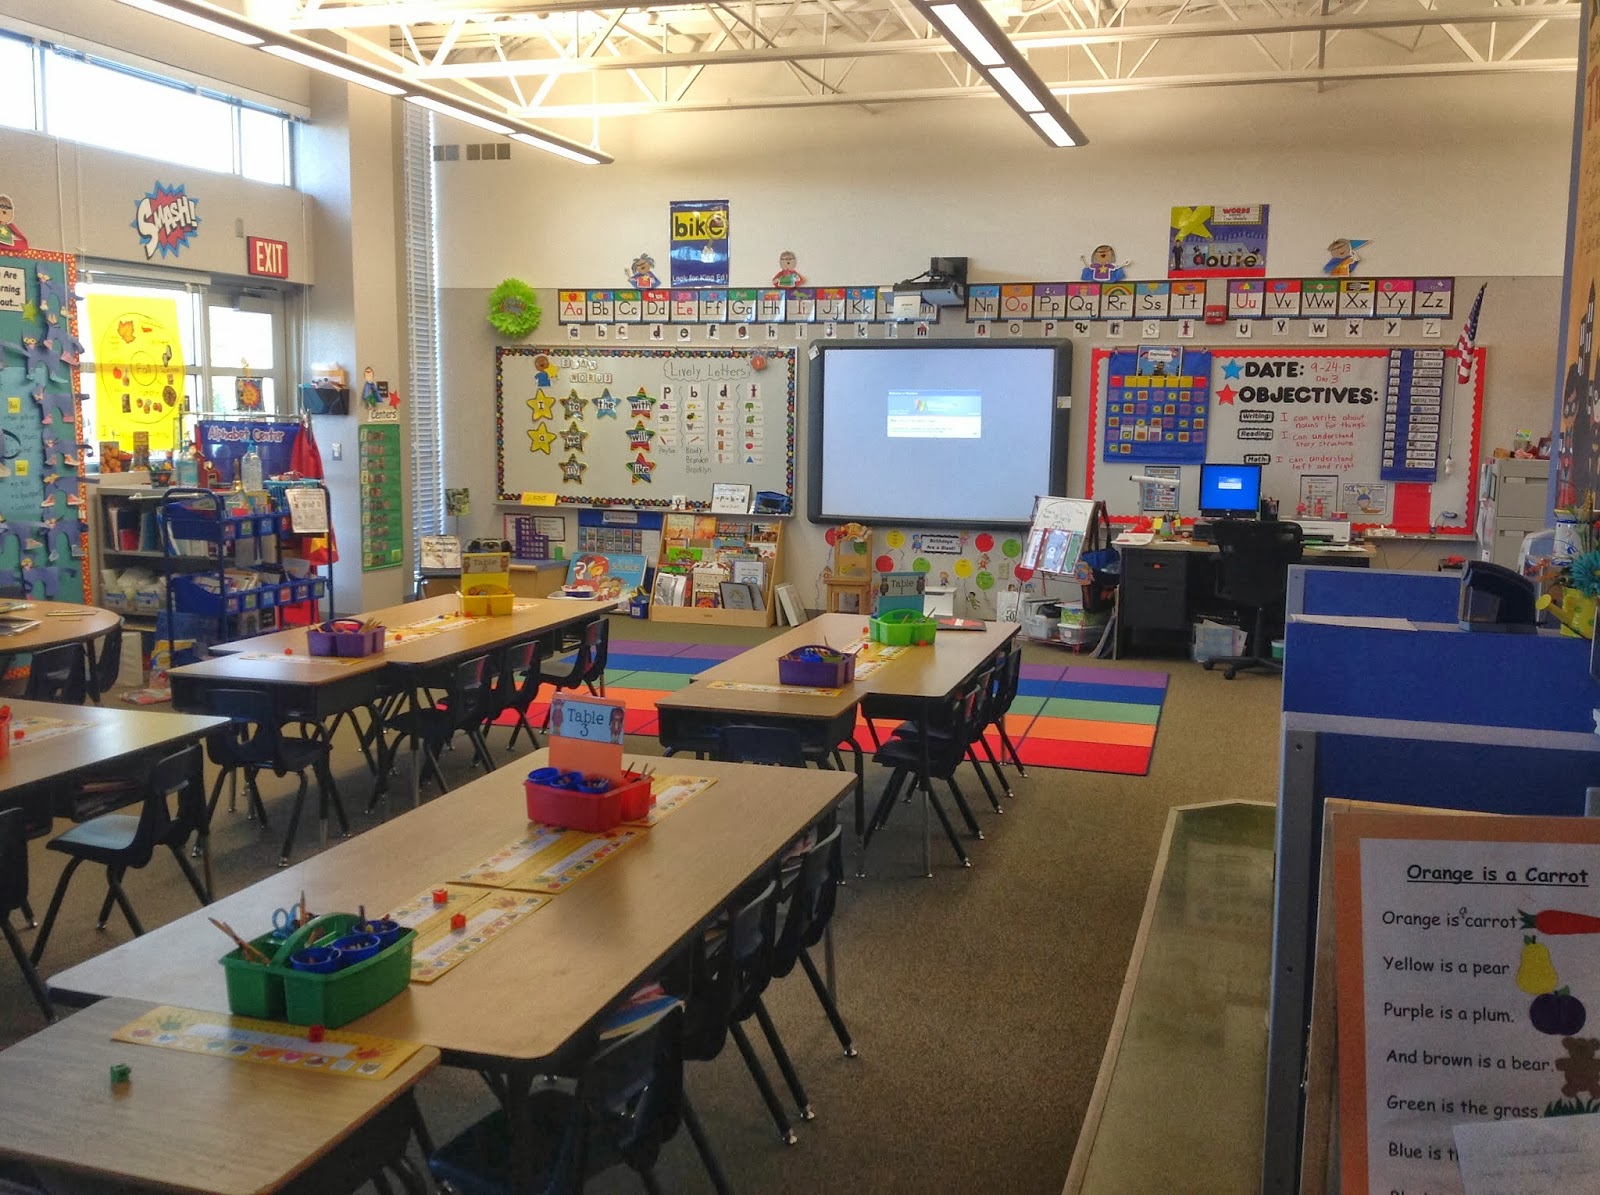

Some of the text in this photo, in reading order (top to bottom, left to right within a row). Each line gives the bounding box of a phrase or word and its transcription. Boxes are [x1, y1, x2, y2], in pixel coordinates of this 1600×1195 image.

[137, 196, 198, 260] SMASH!
[674, 214, 724, 237] bike
[256, 241, 283, 274] EXIT
[4, 270, 17, 279] Are
[0, 285, 20, 296] rning
[0, 299, 19, 307] out...
[563, 301, 583, 316] Aa
[592, 301, 609, 316] Bb
[619, 301, 637, 315] Cc
[647, 301, 665, 315] Dd
[676, 301, 693, 315] Ee
[705, 301, 721, 315] Ff
[762, 301, 780, 315] Hh
[823, 300, 840, 320] Jj
[852, 300, 870, 314] Kk
[974, 297, 993, 312] Nn
[1005, 297, 1028, 312] Oo
[1040, 296, 1060, 317] Pp
[1069, 295, 1096, 317] Qq
[1108, 295, 1126, 311] Rr
[1142, 295, 1161, 310] Ss
[1178, 293, 1197, 310] Tt
[1236, 293, 1256, 309] Uu
[1274, 293, 1291, 308] Vv
[1305, 293, 1334, 308] Ww
[1346, 292, 1367, 308] Xx
[1384, 291, 1406, 315] Yy
[1422, 291, 1444, 308] Zz
[671, 362, 746, 380] Lively Letters
[1245, 361, 1305, 378] DATE:
[1331, 374, 1339, 384] 3
[663, 386, 671, 399] p
[690, 386, 698, 398] b
[720, 384, 727, 397] d
[750, 384, 757, 398] t
[1238, 386, 1379, 404] OBJECTIVES:
[538, 401, 543, 410] I
[569, 402, 580, 411] to
[598, 400, 614, 409] the
[631, 401, 650, 410] with
[371, 410, 397, 419] Centers
[1242, 413, 1271, 421] Writing:
[1280, 412, 1288, 422] I
[208, 425, 285, 442] Alphabet Center
[632, 433, 648, 441] will
[1241, 430, 1271, 438] Reading:
[1281, 430, 1288, 439] I
[634, 464, 650, 474] like
[1335, 463, 1354, 472] right
[473, 559, 497, 567] Table
[892, 579, 914, 588] Table
[567, 708, 604, 725] Table
[580, 724, 589, 737] 3
[1407, 864, 1589, 884] Orange is a Carrot
[1382, 911, 1441, 930] Orange
[1446, 912, 1459, 927] is
[1465, 915, 1518, 930] carrot
[1383, 956, 1510, 978] Yellow is a pear
[1384, 1003, 1514, 1025] Purple is a plum.
[1386, 1050, 1554, 1073] And brown is a bear.
[1387, 1095, 1436, 1112] Green
[1441, 1098, 1454, 1113] is
[1460, 1100, 1488, 1116] the
[1388, 1142, 1441, 1161] Blue is
